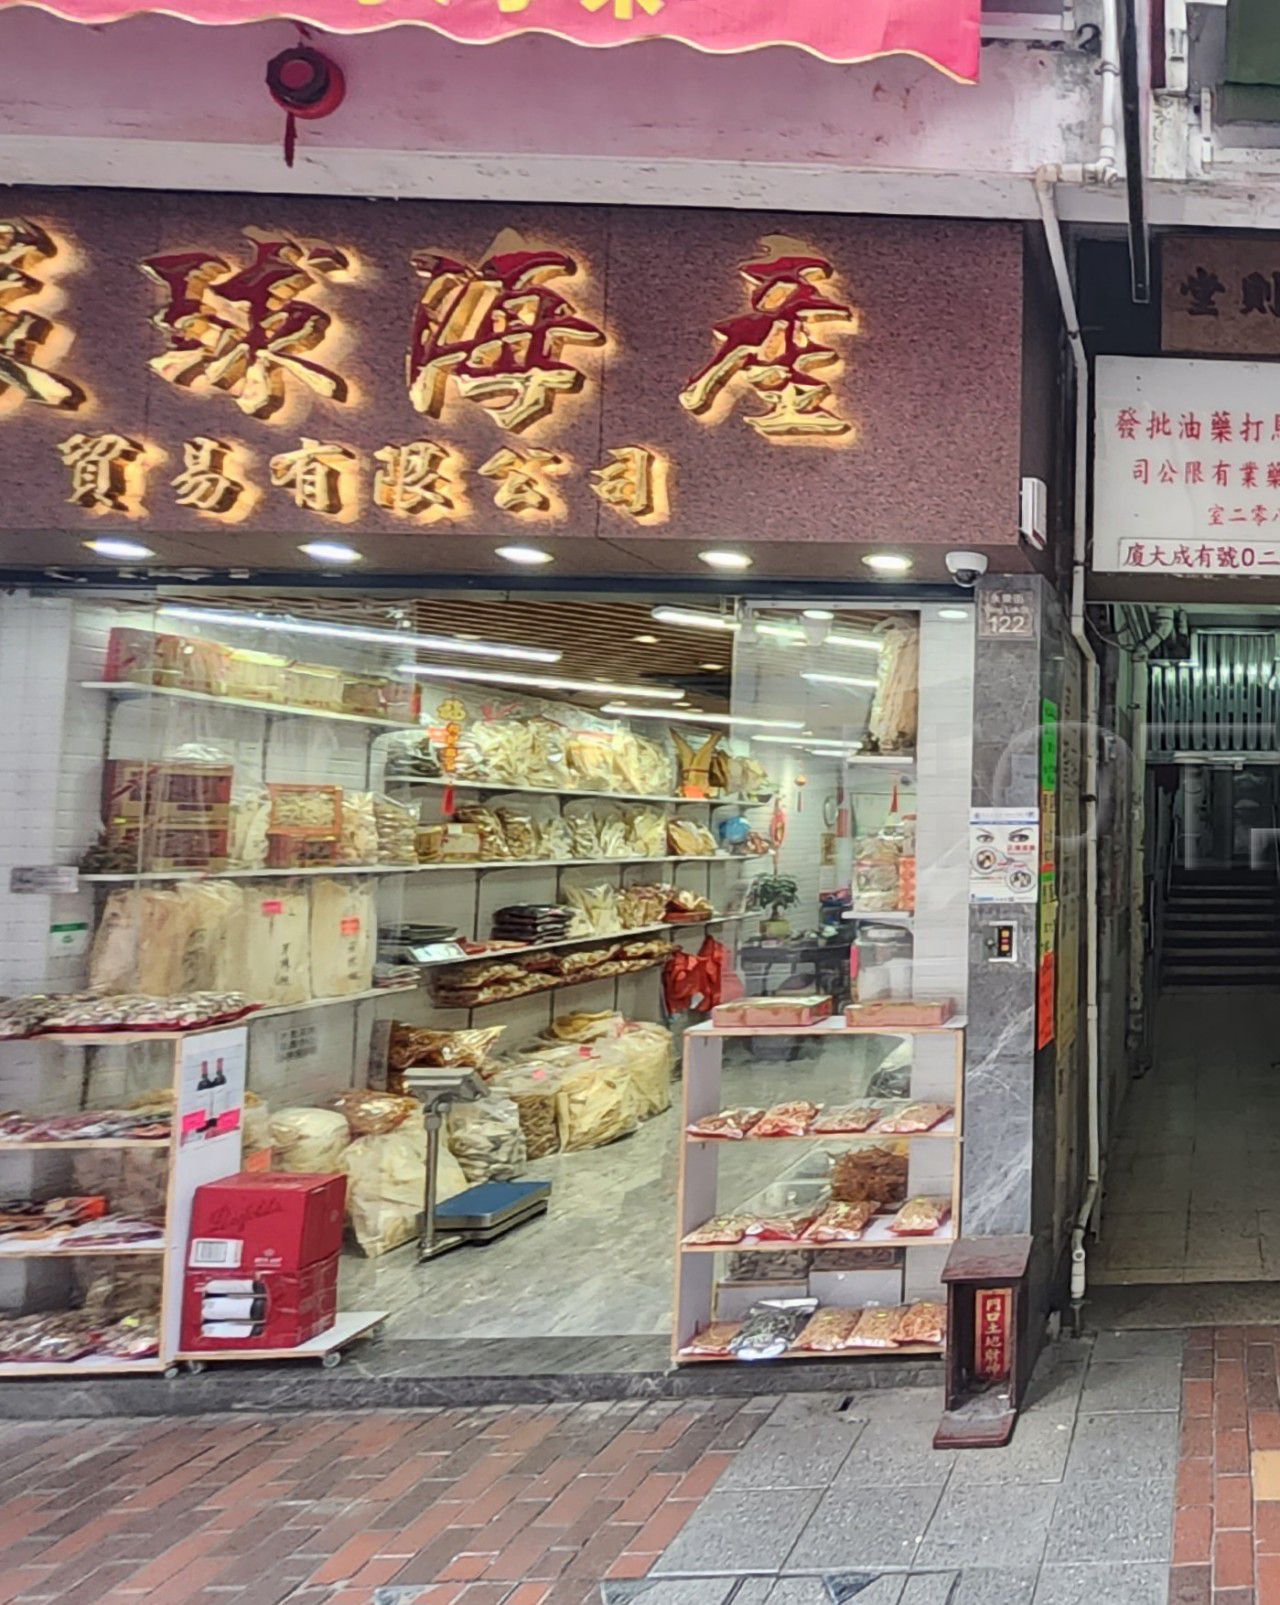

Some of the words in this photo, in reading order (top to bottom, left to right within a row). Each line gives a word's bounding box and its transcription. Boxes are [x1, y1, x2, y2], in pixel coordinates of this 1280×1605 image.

[58, 434, 656, 516] 貿易有限公司
[988, 615, 1028, 633] 122
